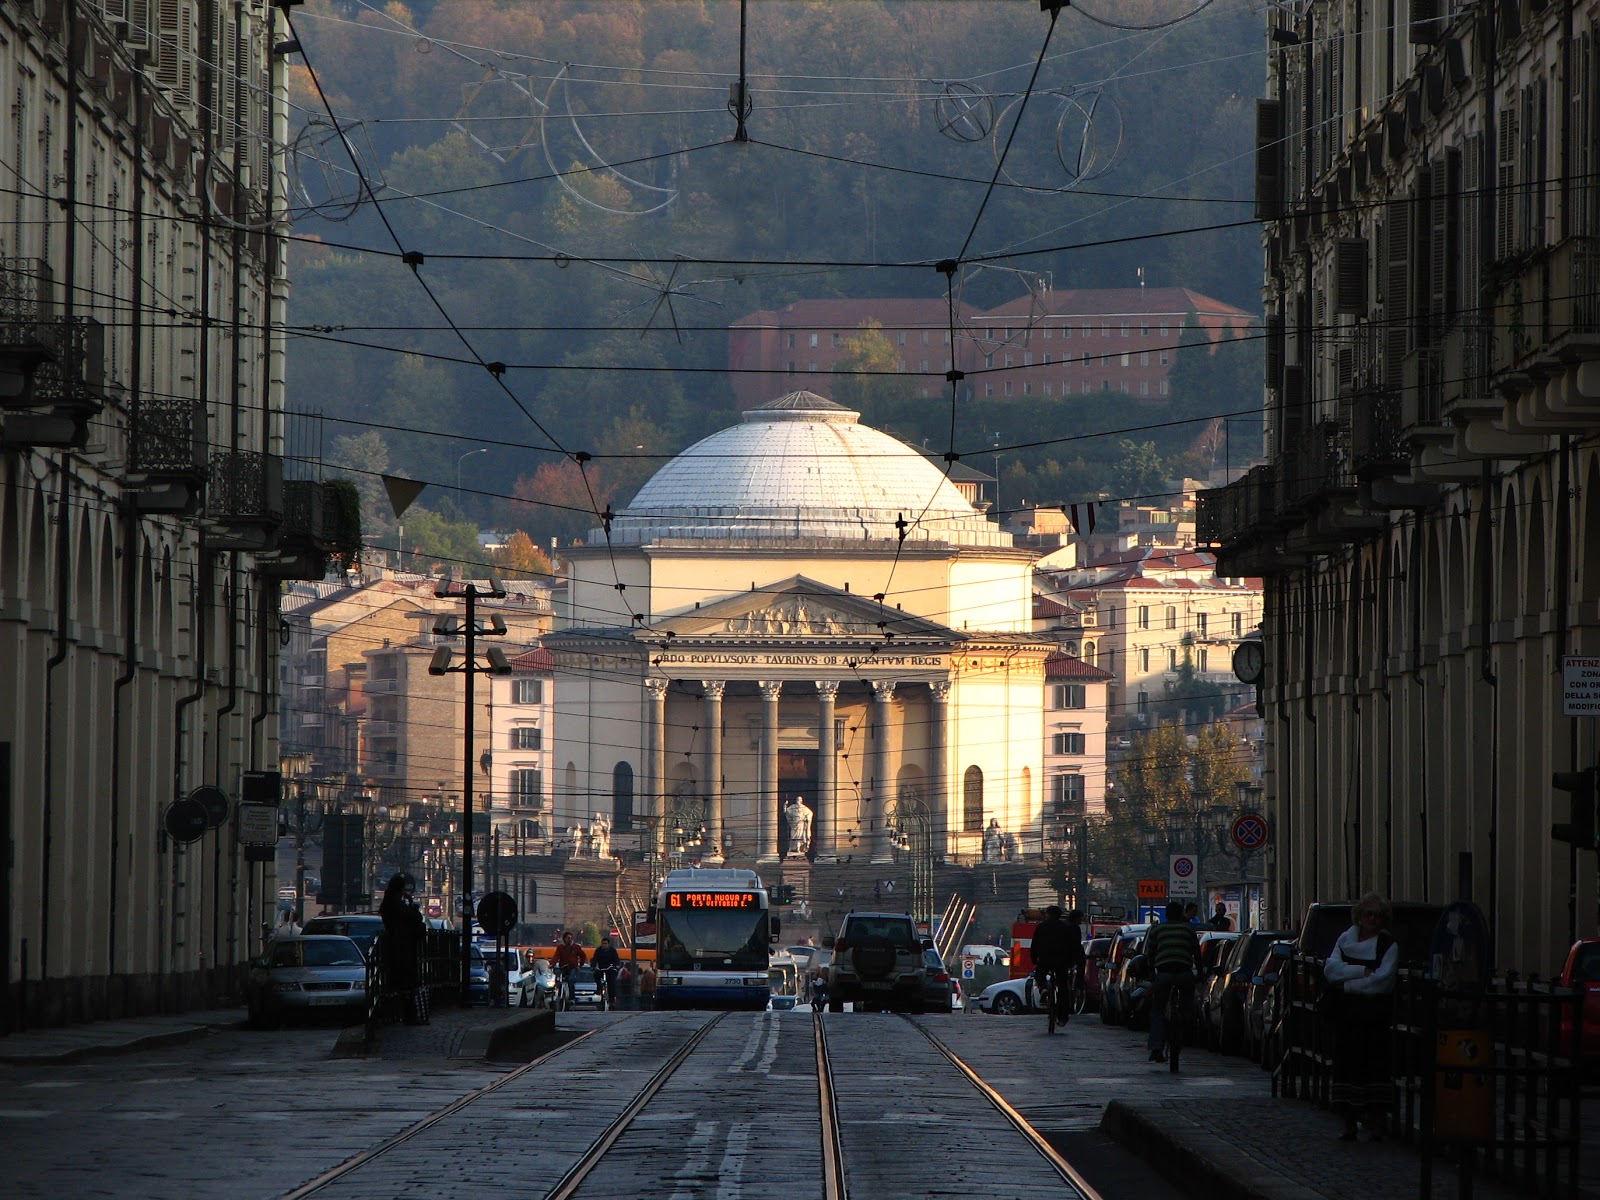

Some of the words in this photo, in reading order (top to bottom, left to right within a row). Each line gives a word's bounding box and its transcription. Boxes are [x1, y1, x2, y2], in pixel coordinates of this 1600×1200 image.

[655, 654, 685, 664] ORDO
[691, 654, 759, 664] POPVLVSQVE
[764, 655, 818, 665] TAVRINVS
[823, 655, 837, 665] OB
[842, 656, 905, 665] ADVENTVM
[911, 657, 942, 666] REGIS
[1140, 885, 1164, 893] TAXI
[670, 893, 682, 907] 61
